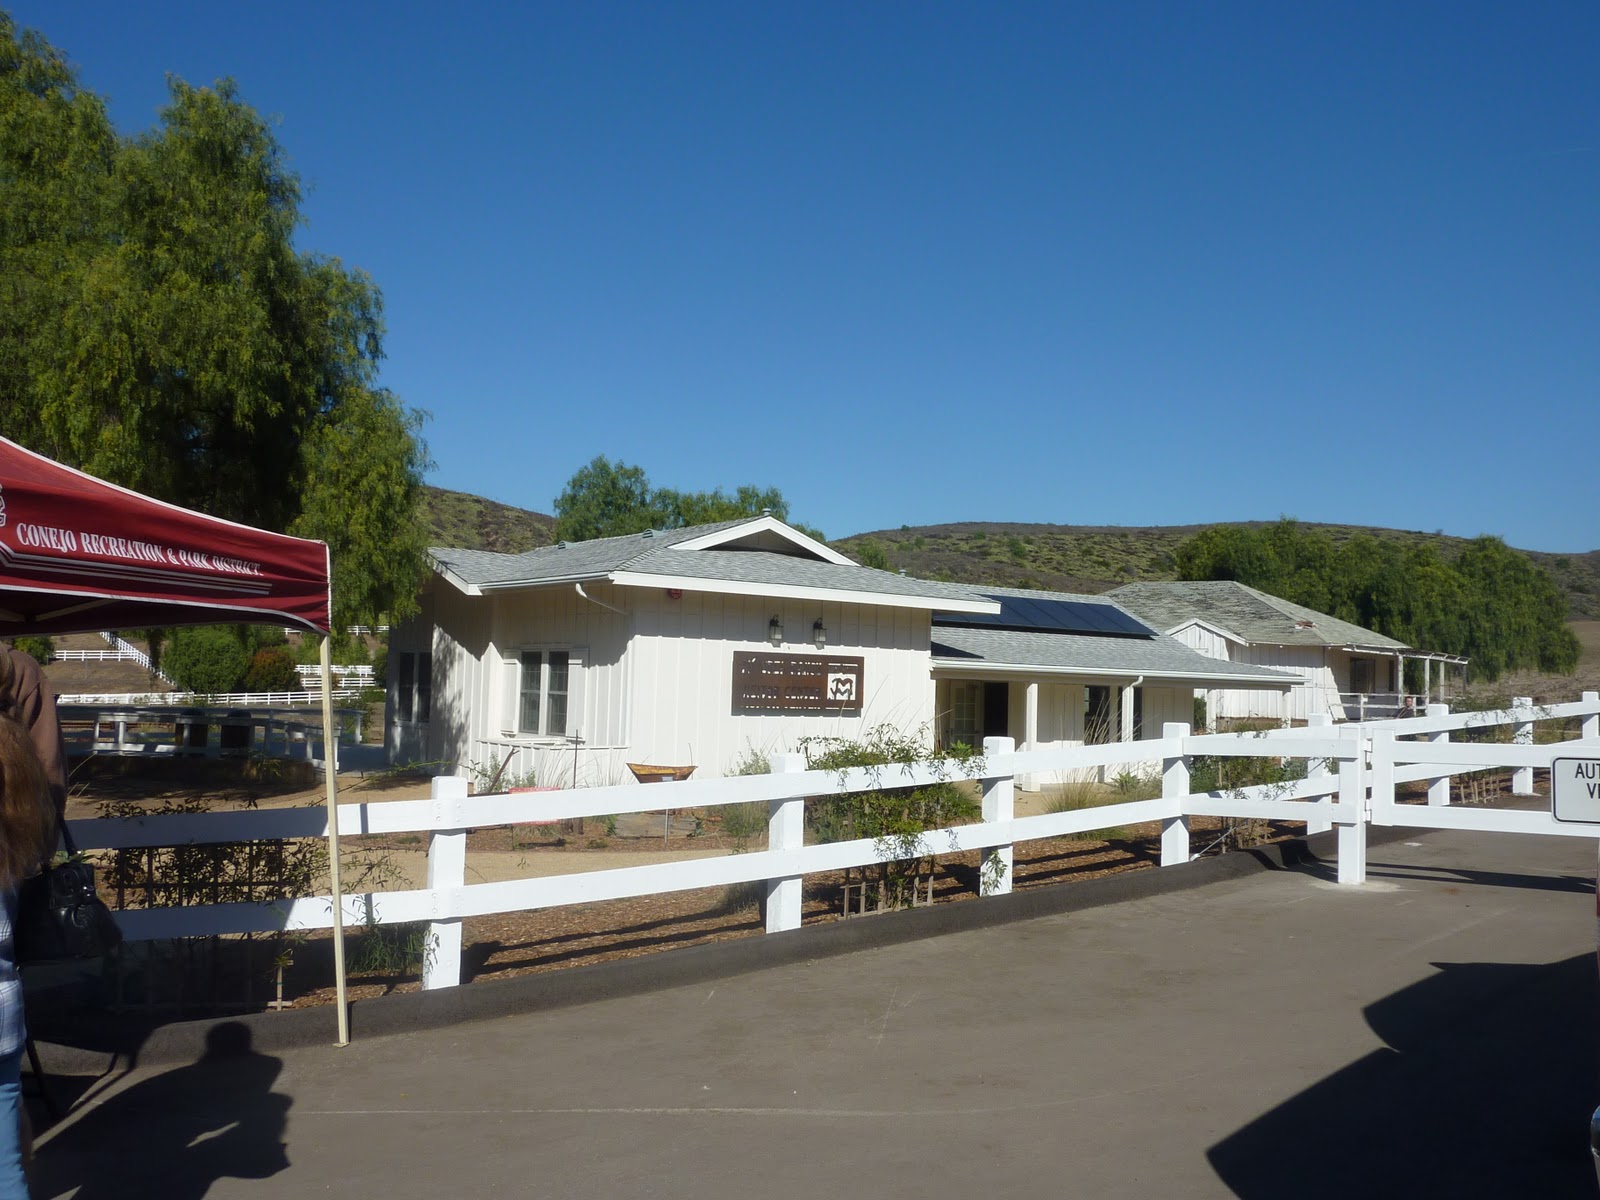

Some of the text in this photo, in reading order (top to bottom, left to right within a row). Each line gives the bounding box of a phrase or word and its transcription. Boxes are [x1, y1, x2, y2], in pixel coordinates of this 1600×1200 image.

[16, 522, 77, 553] CONEJO
[80, 532, 167, 563] RECREATION
[167, 547, 181, 565] &
[179, 549, 215, 570] PARK
